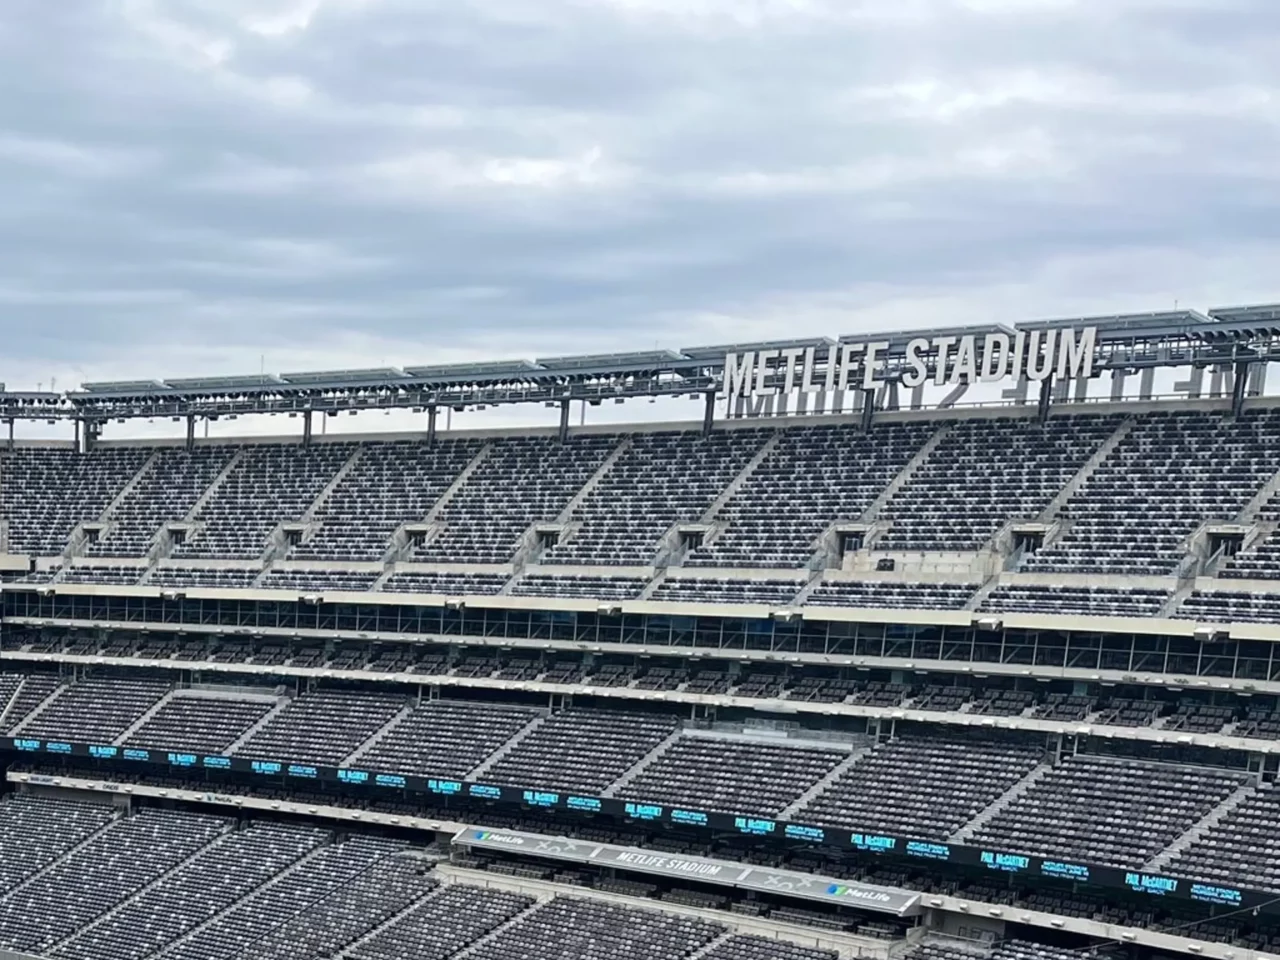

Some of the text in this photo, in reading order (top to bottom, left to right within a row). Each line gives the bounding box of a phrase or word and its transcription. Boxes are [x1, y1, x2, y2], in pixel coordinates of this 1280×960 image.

[722, 340, 889, 398] METLIFE
[902, 326, 1096, 389] STADIUM
[488, 834, 524, 844] MetLife
[616, 852, 722, 875] METLIFE STADIUM
[845, 888, 891, 901] MetLife
